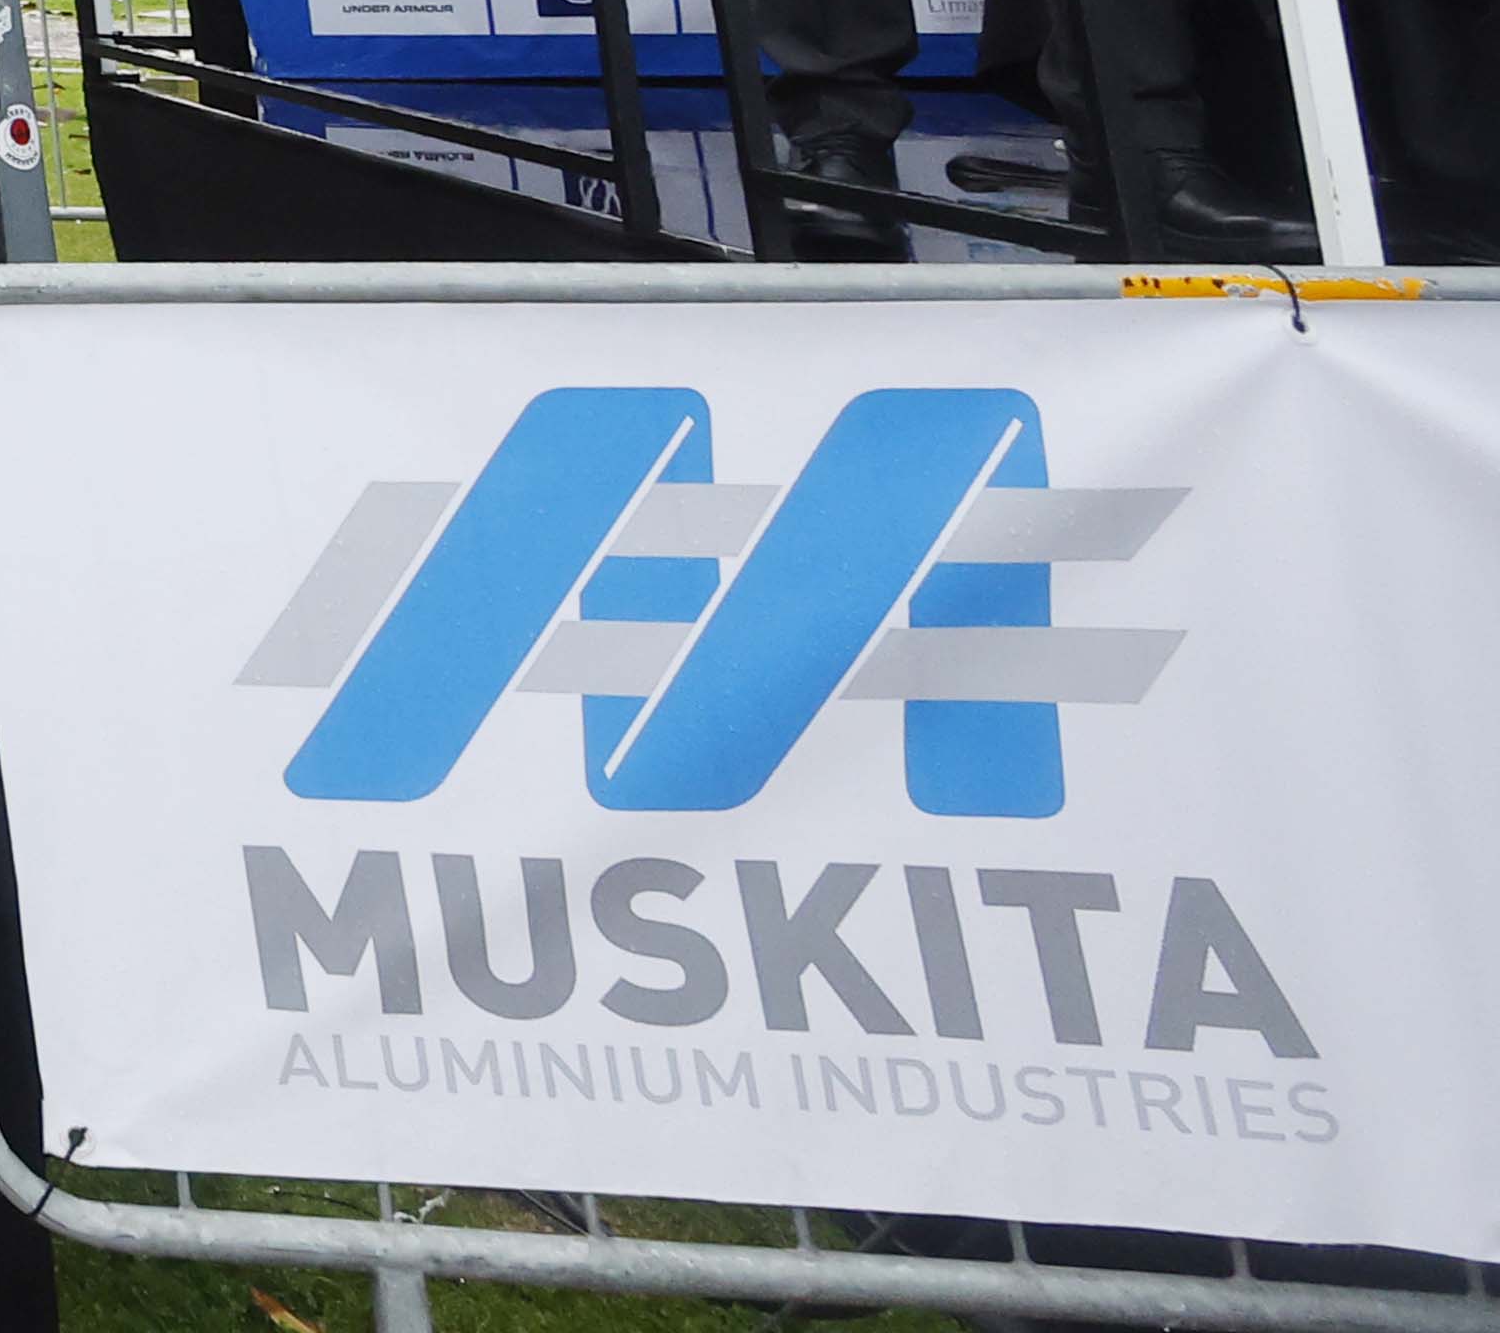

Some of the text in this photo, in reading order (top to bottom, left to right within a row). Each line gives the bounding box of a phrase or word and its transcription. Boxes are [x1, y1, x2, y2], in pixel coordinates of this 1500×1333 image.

[342, 3, 454, 14] UNDER ARMOUR
[242, 844, 1320, 1059] MUSKITA
[278, 1033, 1341, 1145] ALUMINIUM INDUSTRIES
